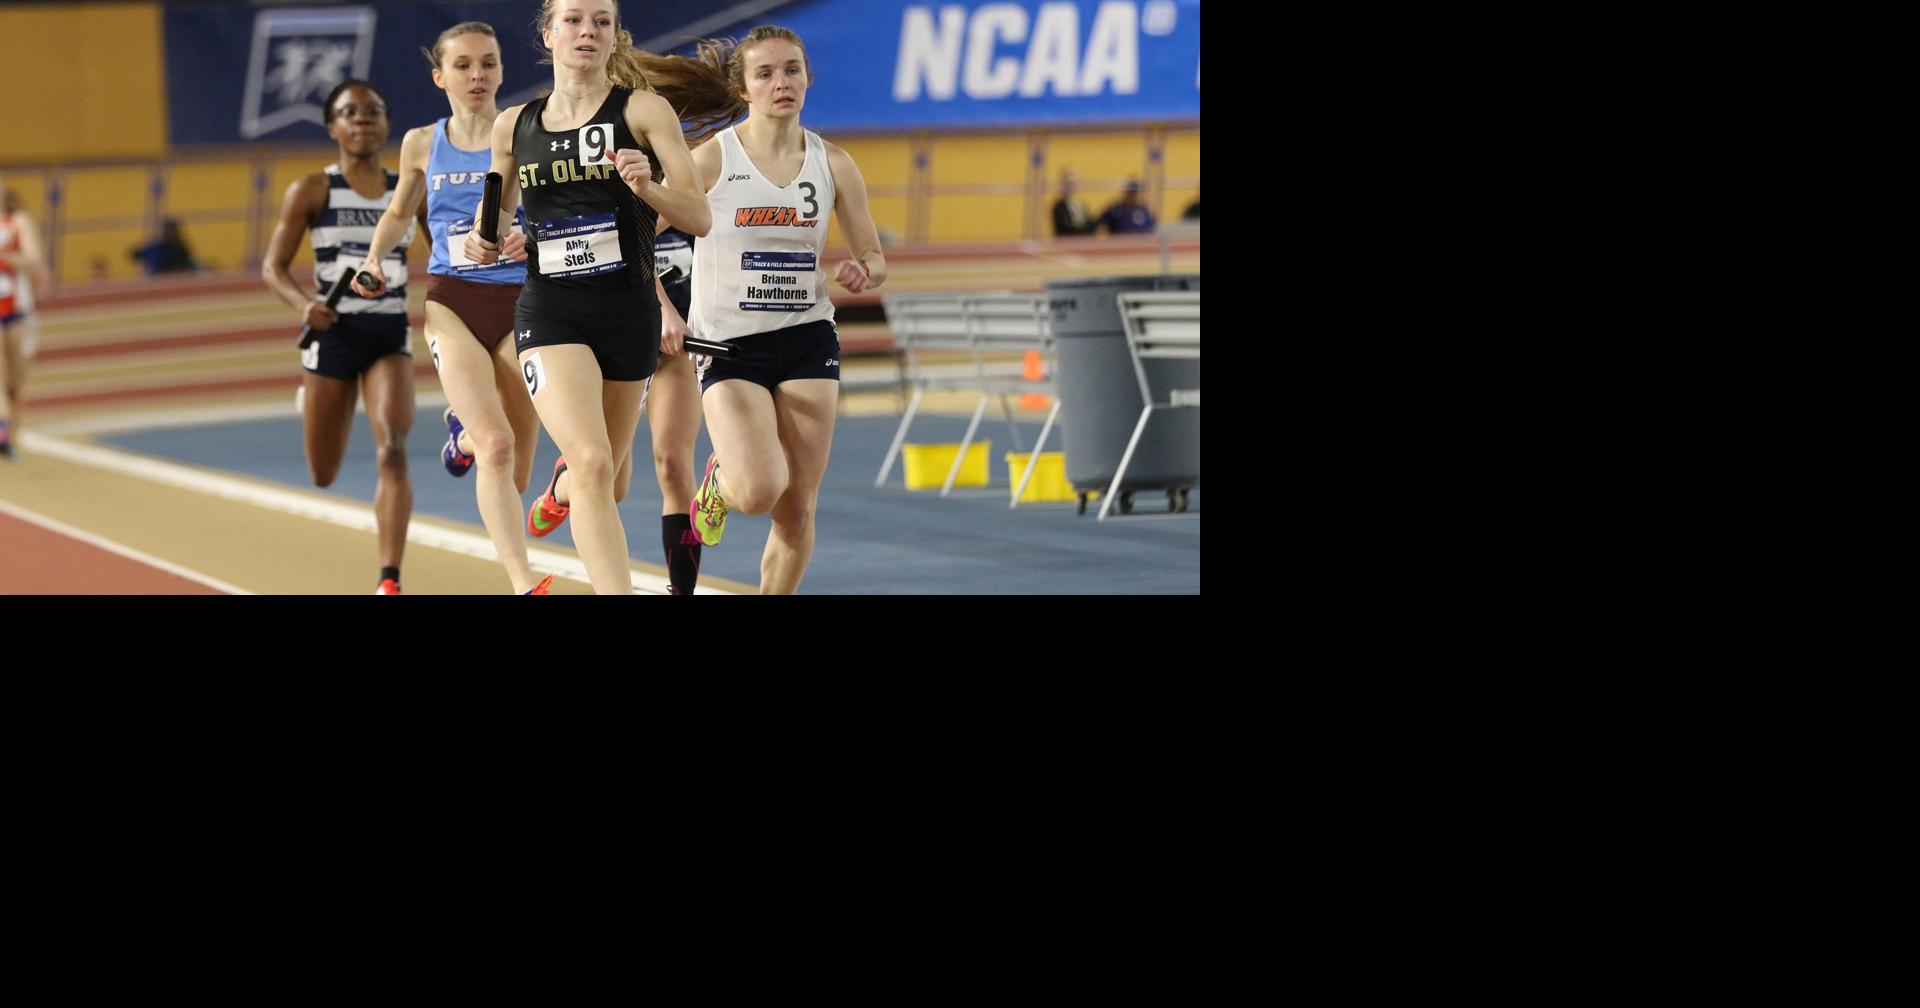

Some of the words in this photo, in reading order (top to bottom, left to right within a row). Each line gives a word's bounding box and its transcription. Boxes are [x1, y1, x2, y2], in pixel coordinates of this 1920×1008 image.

[893, 2, 1139, 101] NCAA
[585, 126, 606, 162] 9
[431, 172, 486, 191] TUF
[518, 163, 546, 189] ST.
[798, 181, 819, 218] 3
[735, 206, 818, 228] WHEAT
[564, 227, 577, 235] FIELD
[761, 274, 797, 285] Brianna
[746, 286, 808, 300] Hawthorne
[524, 360, 538, 396] 9
